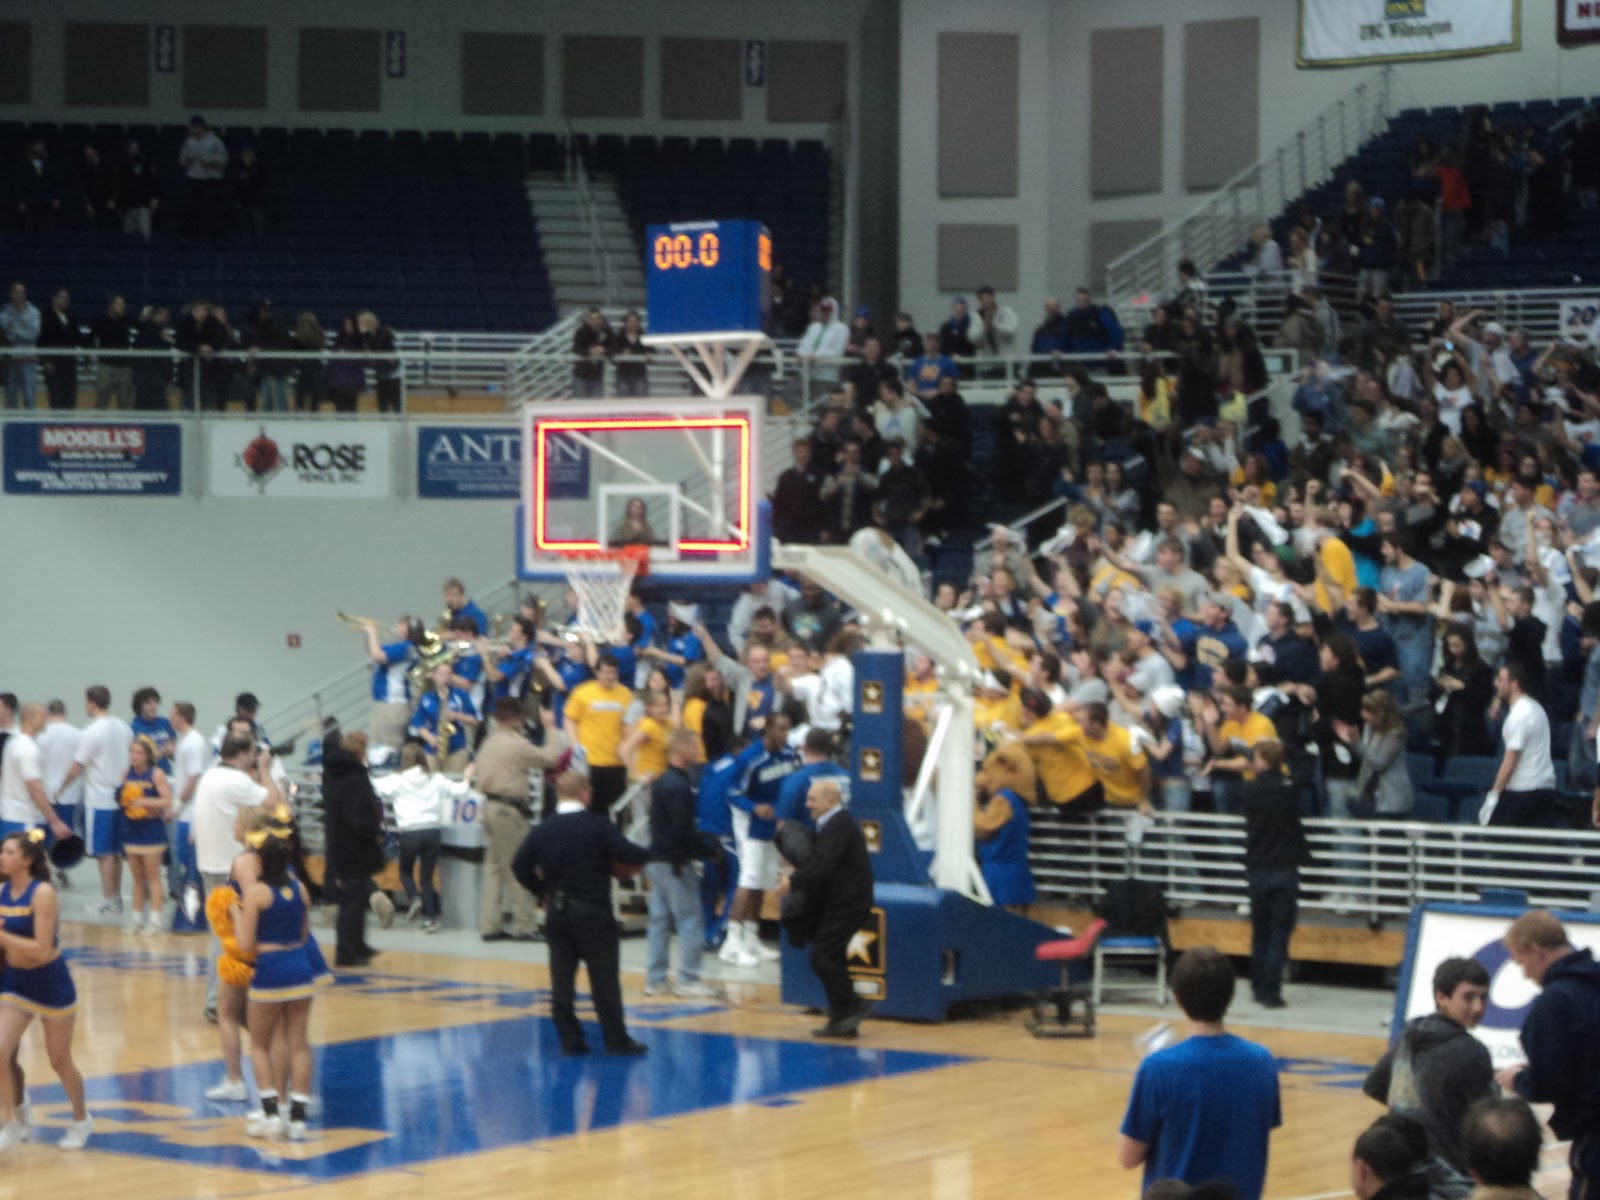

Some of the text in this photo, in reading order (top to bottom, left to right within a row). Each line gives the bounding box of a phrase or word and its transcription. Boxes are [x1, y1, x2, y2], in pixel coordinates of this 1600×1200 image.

[654, 232, 719, 270] 00.0
[42, 428, 143, 448] MODELL'S
[293, 443, 366, 471] ROSE
